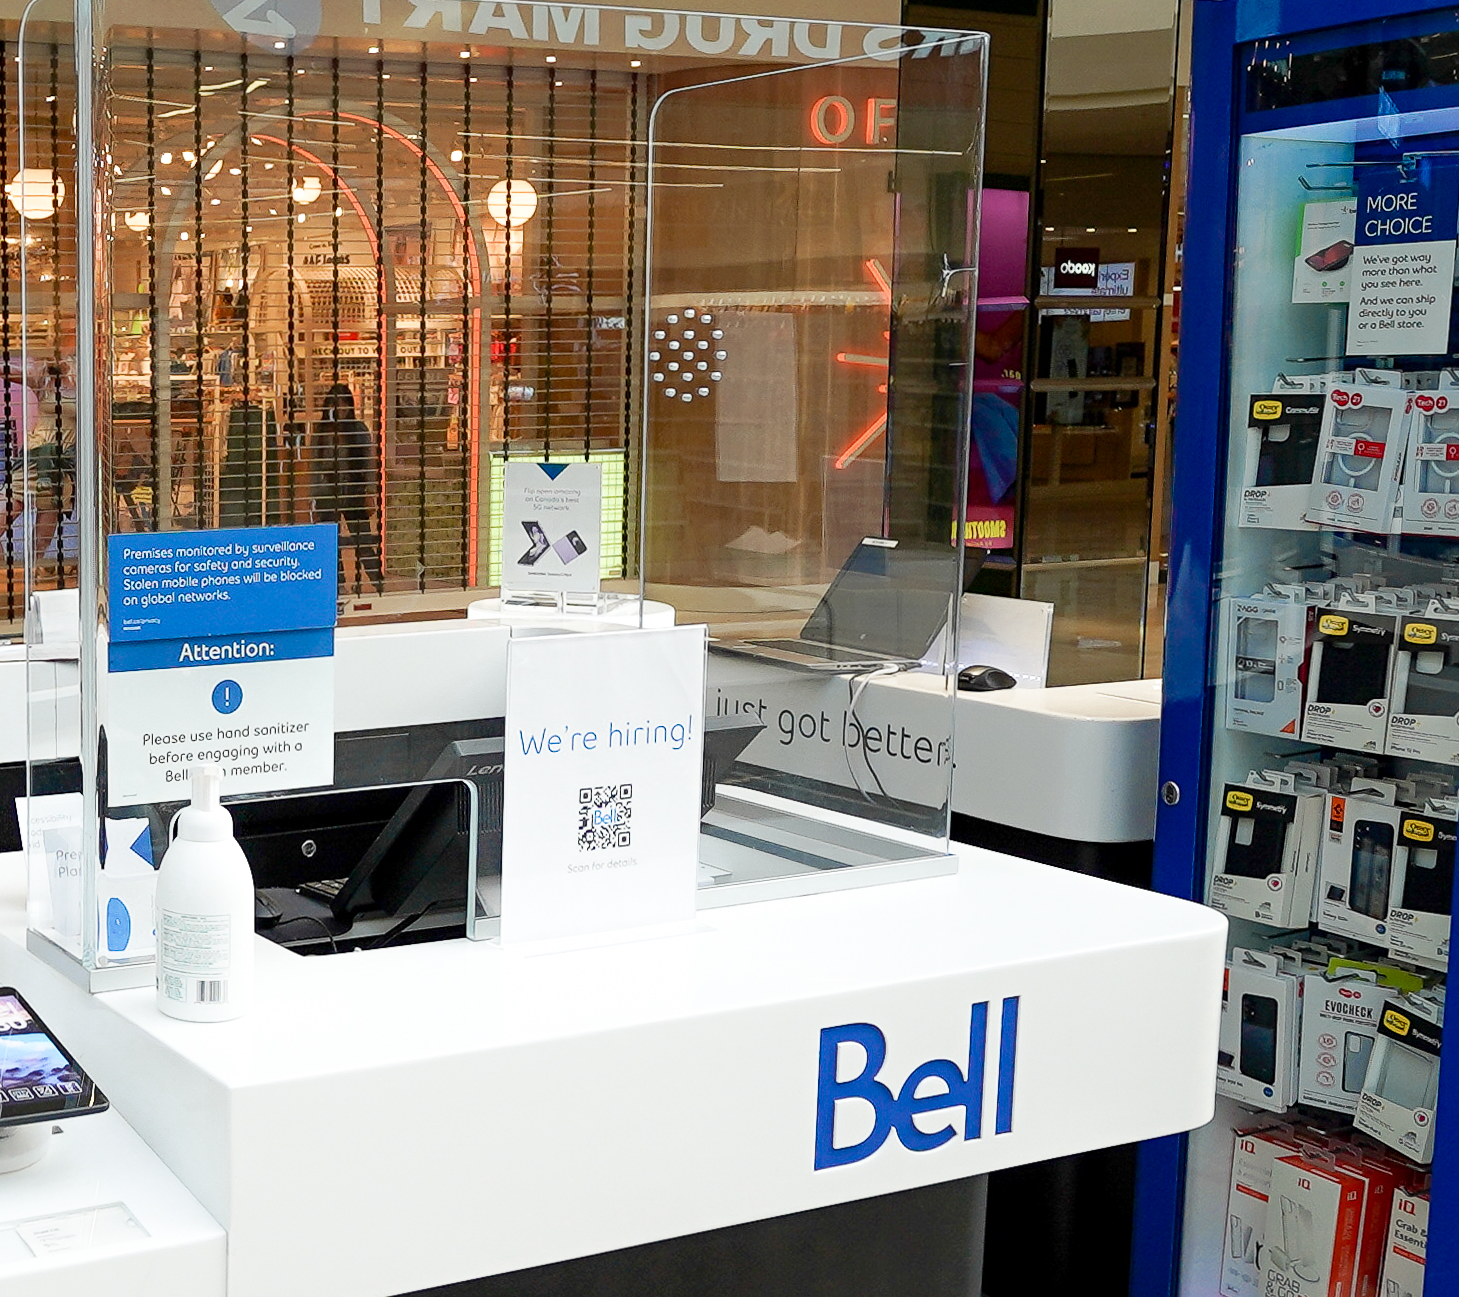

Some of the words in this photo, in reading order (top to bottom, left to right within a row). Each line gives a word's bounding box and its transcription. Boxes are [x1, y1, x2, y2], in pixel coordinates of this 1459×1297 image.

[1367, 193, 1418, 213] MORE
[1365, 216, 1432, 237] CHOICE
[1363, 255, 1389, 265] We've
[1392, 255, 1408, 265] got
[1411, 254, 1431, 263] way
[1362, 268, 1387, 277] more
[1389, 267, 1410, 275] than
[1412, 265, 1437, 274] what
[1361, 282, 1378, 291] you
[1399, 278, 1423, 287] here.
[1360, 296, 1378, 305] And
[1415, 295, 1436, 305] ship
[1359, 308, 1394, 319] directly
[1408, 308, 1426, 318] you
[1379, 320, 1395, 329] Bell
[1397, 320, 1424, 328] store.
[123, 547, 173, 560] Premises
[176, 544, 232, 558] monitored
[235, 544, 249, 557] by
[252, 540, 315, 553] surveillance
[123, 564, 172, 575] cameras
[174, 561, 191, 573] for
[194, 560, 229, 573] safety
[231, 557, 252, 570] and
[255, 556, 300, 570] security.
[123, 579, 159, 591] Stolen
[161, 575, 198, 588] mobile
[201, 574, 241, 589] phones
[243, 572, 261, 584] will
[263, 571, 278, 583] be
[280, 569, 322, 582] blocked
[123, 596, 138, 606] on
[141, 593, 175, 608] global
[178, 589, 231, 603] networks.
[179, 639, 275, 663] Attention:
[1308, 704, 1331, 714] DROP
[778, 708, 831, 746] got
[1391, 716, 1416, 725] DROP
[143, 730, 186, 746] Please
[190, 730, 213, 743] use
[217, 726, 250, 740] hand
[253, 721, 309, 737] sanitizer
[519, 726, 598, 756] We're
[608, 715, 693, 751] hiring!
[149, 749, 193, 764] before
[197, 745, 259, 764] engaging
[263, 740, 291, 754] with
[294, 742, 303, 752] a
[165, 769, 188, 782] Bell
[230, 762, 287, 777] member.
[593, 810, 616, 826] Bell
[566, 861, 590, 874] Scan
[592, 859, 605, 871] for
[606, 856, 639, 870] details.
[1325, 999, 1373, 1019] EVOCHECK
[814, 996, 1021, 1171] Bell
[1396, 1219, 1419, 1234] Grab
[1268, 1269, 1301, 1293] GRAB
